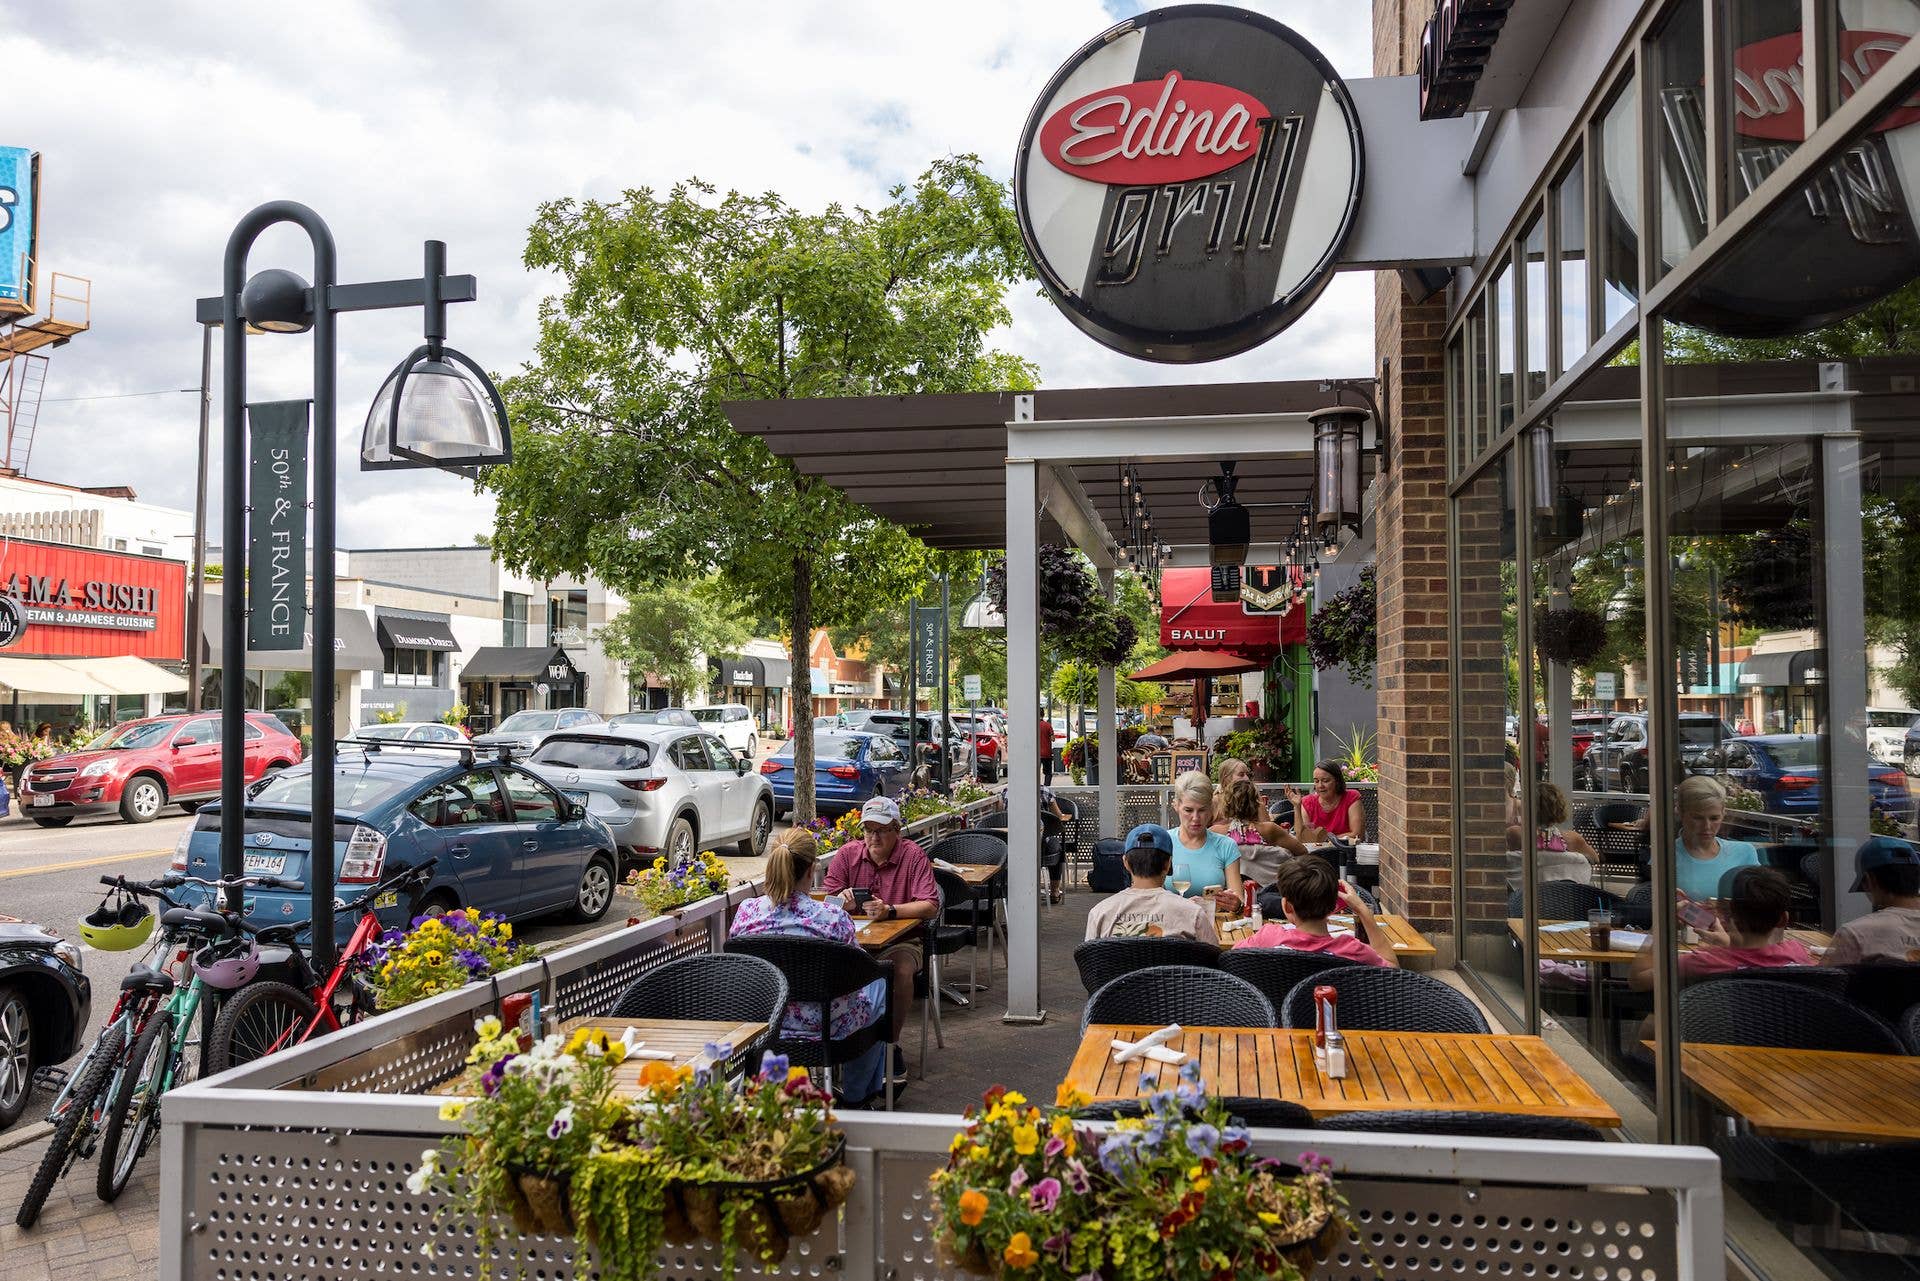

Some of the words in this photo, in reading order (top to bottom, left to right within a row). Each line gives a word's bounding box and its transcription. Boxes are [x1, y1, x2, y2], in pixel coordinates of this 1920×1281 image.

[1059, 74, 1251, 166] Edina
[1096, 115, 1304, 286] grill
[270, 497, 291, 525] &
[84, 581, 160, 612] SUSHI
[271, 530, 290, 636] FRANCE
[56, 612, 64, 622] &
[65, 613, 115, 626] JAPANESE
[116, 616, 156, 628] CUISINE
[1171, 629, 1227, 640] SALUT
[548, 665, 569, 680] WOW
[926, 649, 934, 683] FRANCE
